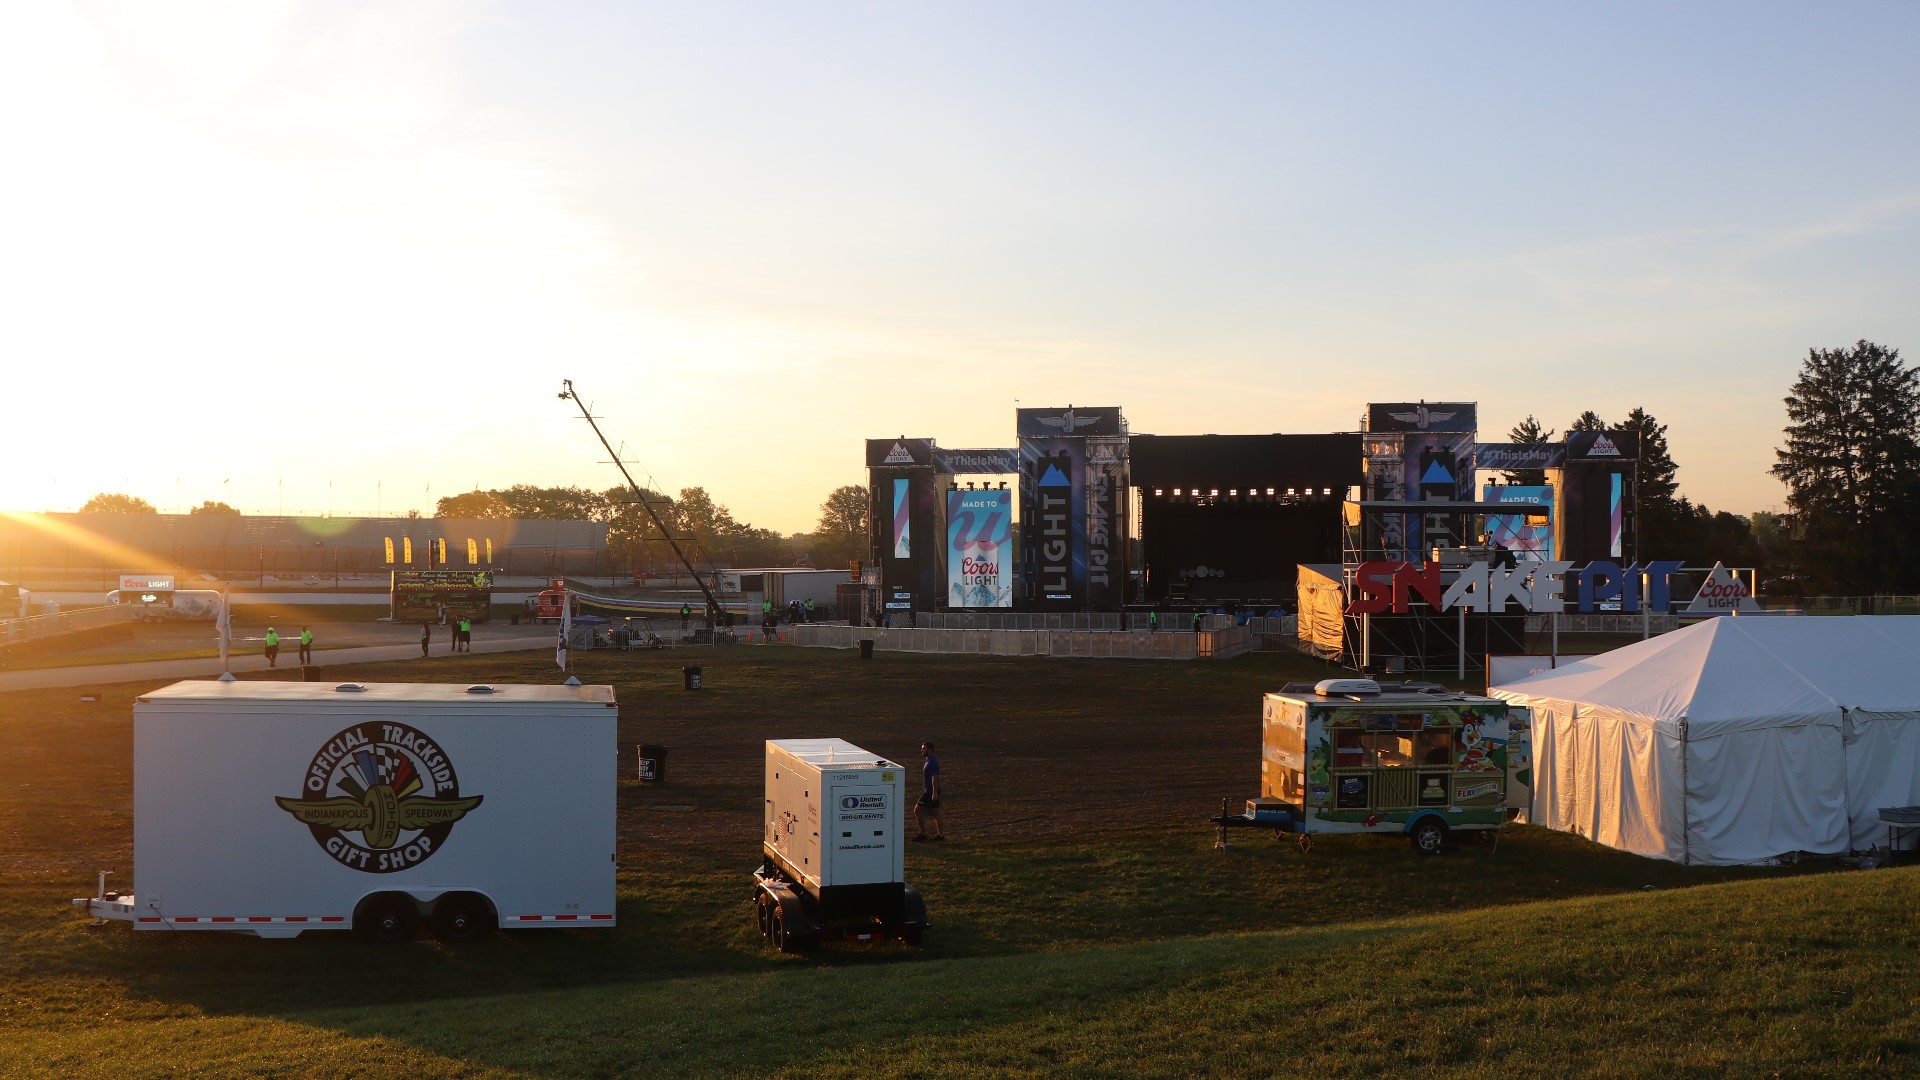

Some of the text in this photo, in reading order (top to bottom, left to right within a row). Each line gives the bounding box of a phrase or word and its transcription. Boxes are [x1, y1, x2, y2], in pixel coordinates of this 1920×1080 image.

[889, 449, 909, 457] Coors
[1592, 441, 1615, 449] Coors
[1042, 493, 1066, 591] LIGHT
[962, 557, 998, 575] Coors
[124, 578, 148, 588] Coors
[966, 576, 997, 585] LIGHT
[1344, 560, 1686, 614] SNAKE PIT
[1700, 578, 1751, 598] Coors
[1708, 598, 1741, 608] LIGHT
[307, 725, 454, 793] OFFICIAL TRACKSIDE
[304, 809, 454, 819] INDIANAPOLIS SPEEDWAY
[384, 791, 395, 840] MOTOR
[326, 836, 432, 870] GIFT SHOP
